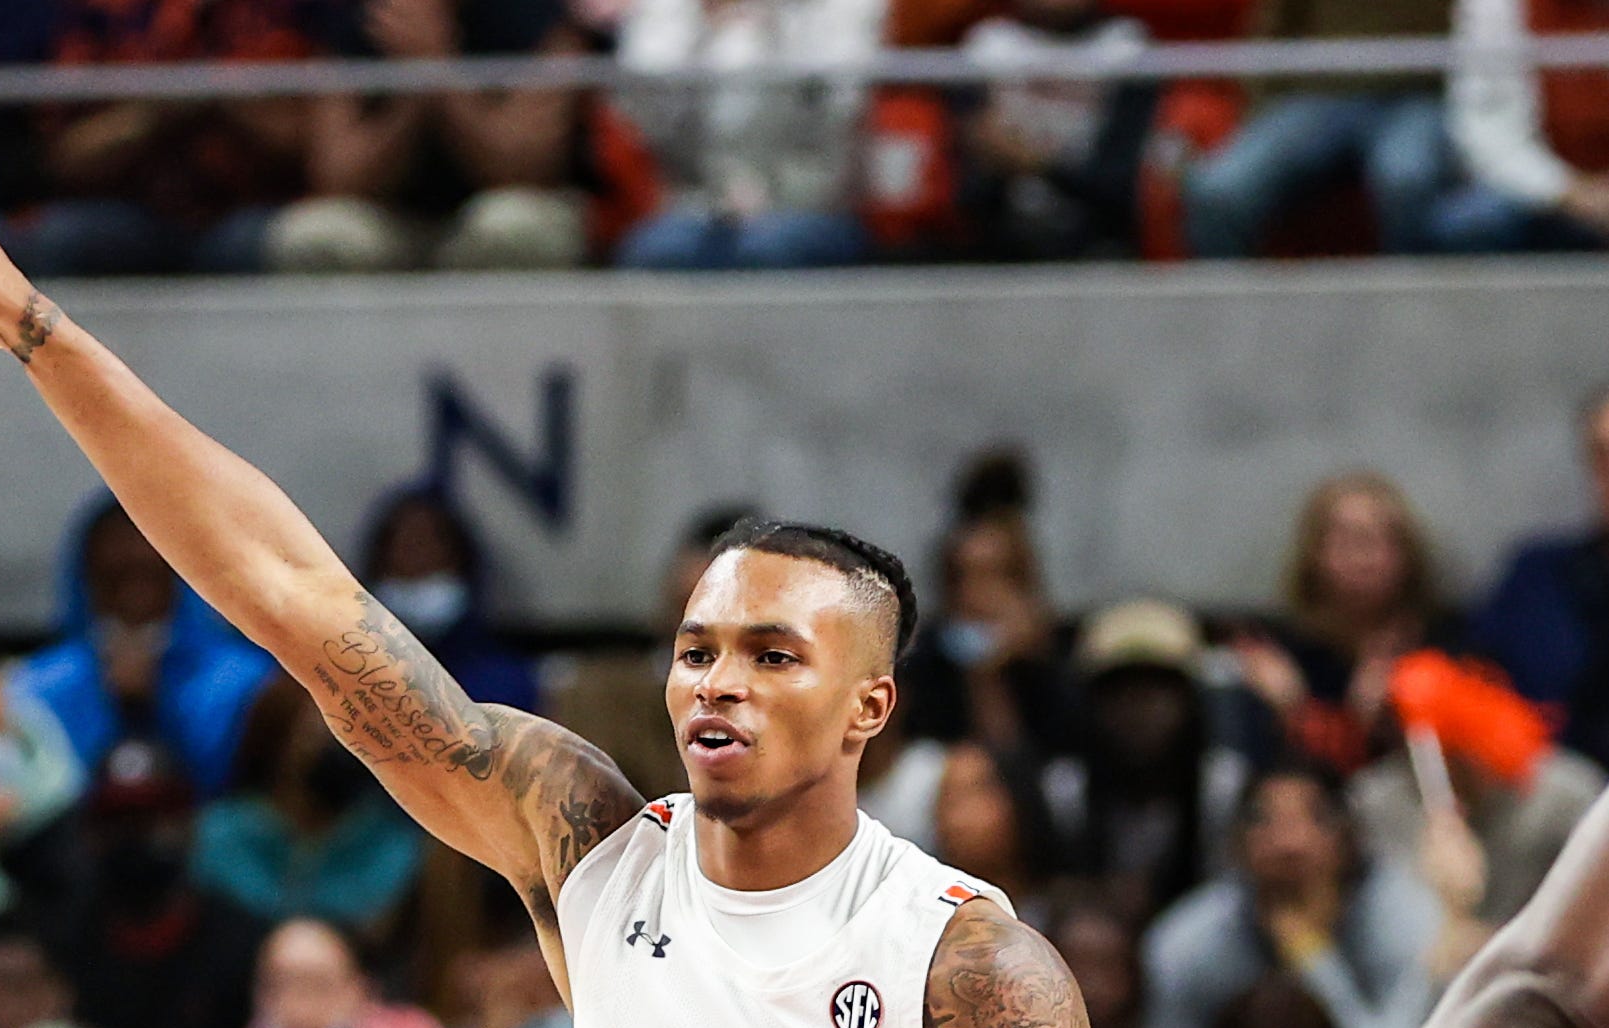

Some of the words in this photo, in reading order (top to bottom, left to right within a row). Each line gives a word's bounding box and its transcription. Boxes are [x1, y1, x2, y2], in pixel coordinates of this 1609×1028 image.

[421, 362, 578, 534] N
[323, 631, 463, 763] Blessed
[340, 695, 361, 721] THE
[354, 689, 379, 713] ARE
